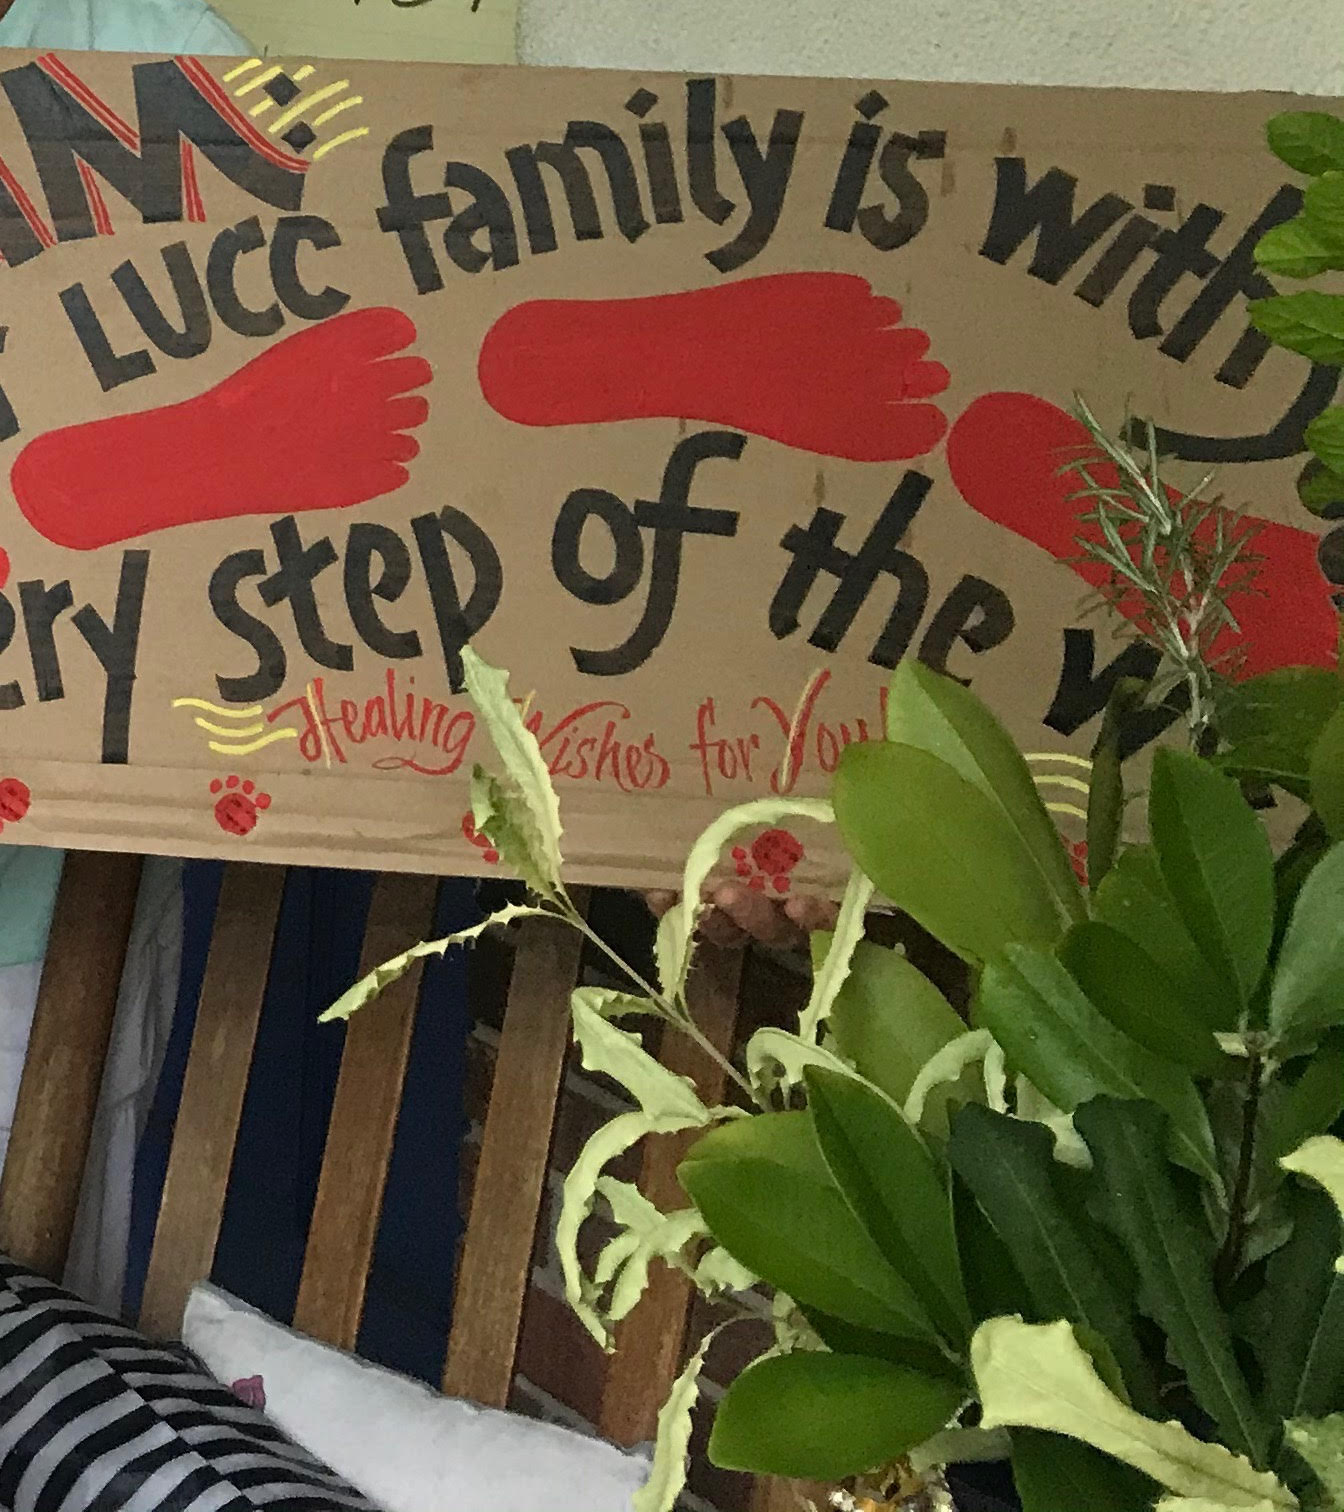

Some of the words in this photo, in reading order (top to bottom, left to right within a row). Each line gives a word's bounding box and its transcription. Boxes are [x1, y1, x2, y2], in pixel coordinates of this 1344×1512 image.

[58, 214, 352, 392] LUCC
[375, 78, 805, 296] family
[824, 90, 947, 252] is
[978, 156, 1305, 391] with
[208, 505, 504, 702] step
[550, 431, 748, 677] of
[768, 470, 1017, 688] the
[266, 668, 476, 776] Healing
[689, 696, 760, 797] for
